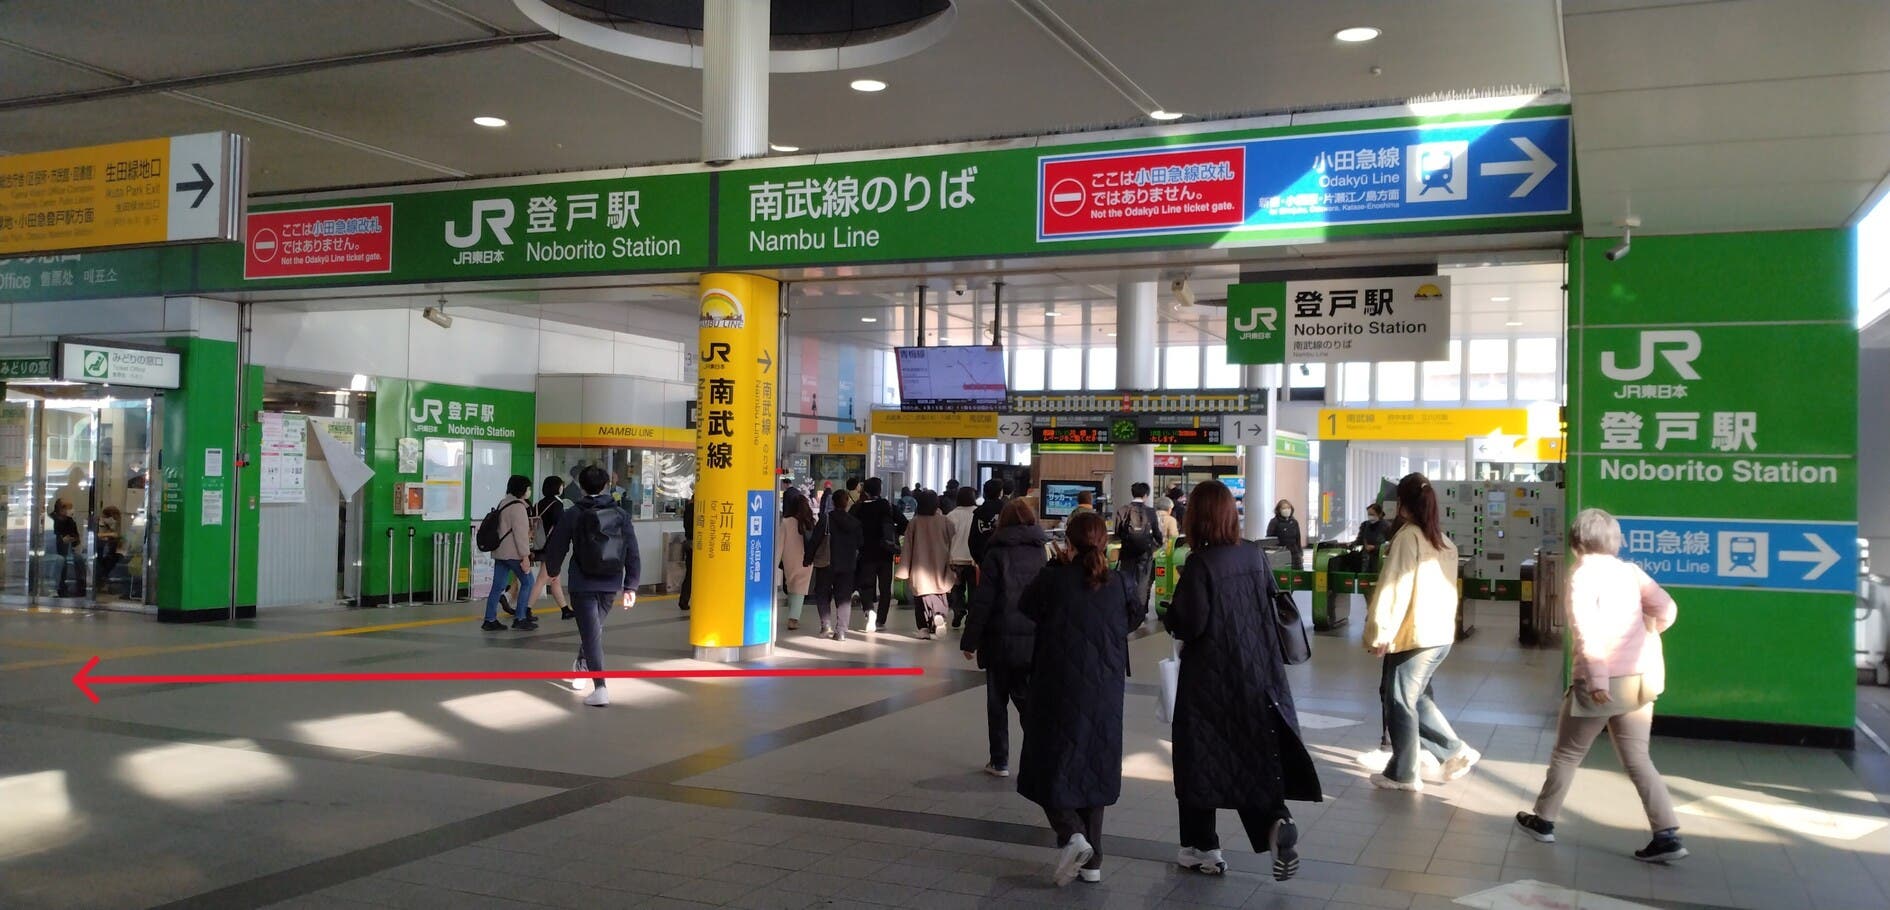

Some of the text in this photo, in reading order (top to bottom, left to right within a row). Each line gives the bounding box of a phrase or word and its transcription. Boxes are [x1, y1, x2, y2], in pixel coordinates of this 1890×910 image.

[105, 159, 161, 183] 生田緑地口
[1313, 147, 1400, 174] 小田急線
[1091, 162, 1234, 188] ここは小田急線改札
[1372, 172, 1400, 184] Line
[145, 184, 160, 194] Exit
[749, 165, 978, 222] 南武線のりば
[1091, 186, 1203, 207] ではありません。
[526, 191, 641, 234] 登戸駅
[1090, 209, 1107, 219] Not
[1108, 208, 1123, 218] the
[1161, 205, 1182, 214] Line
[1184, 203, 1210, 213] ticket
[1211, 202, 1235, 214] gate.
[282, 216, 382, 237] ここは小田急線改札
[444, 198, 515, 249] JR
[282, 237, 360, 254] ではありません。
[526, 235, 681, 262] Noborito Station
[749, 226, 880, 252] Nambu Line
[281, 257, 292, 265] Not
[331, 255, 345, 263] Line
[346, 253, 365, 262] ticket
[366, 253, 382, 263] gate.
[453, 249, 504, 265] JR東日本
[83, 265, 119, 285] 매표소
[1293, 288, 1394, 318] 登戸駅
[1234, 307, 1278, 332] JR
[1293, 320, 1427, 336] Noborito Station
[1239, 332, 1272, 340] JR東日本
[1293, 340, 1352, 351] 南武線のりば
[112, 352, 164, 367] みどりの窓口
[701, 342, 731, 362] JR
[1600, 329, 1702, 381] JR
[1614, 384, 1688, 399] JR東日本
[410, 399, 443, 425] JR
[448, 401, 494, 423] 登戸駅
[697, 378, 706, 440] Nambu
[761, 381, 772, 436] 南武線
[414, 425, 438, 433] JR東日本
[448, 423, 515, 438] Noborito Station
[598, 426, 654, 437] NAMBU LINE
[706, 377, 735, 469] 南武線
[1233, 420, 1242, 439] 1
[1327, 414, 1337, 436] 1
[1600, 411, 1758, 451] 登戸駅
[1600, 459, 1837, 484] Noborito Station
[708, 500, 718, 560] for Tachikawa
[719, 500, 735, 552] 立川 方面
[753, 539, 762, 582] 小田急線
[1631, 558, 1711, 575] akyū Line
